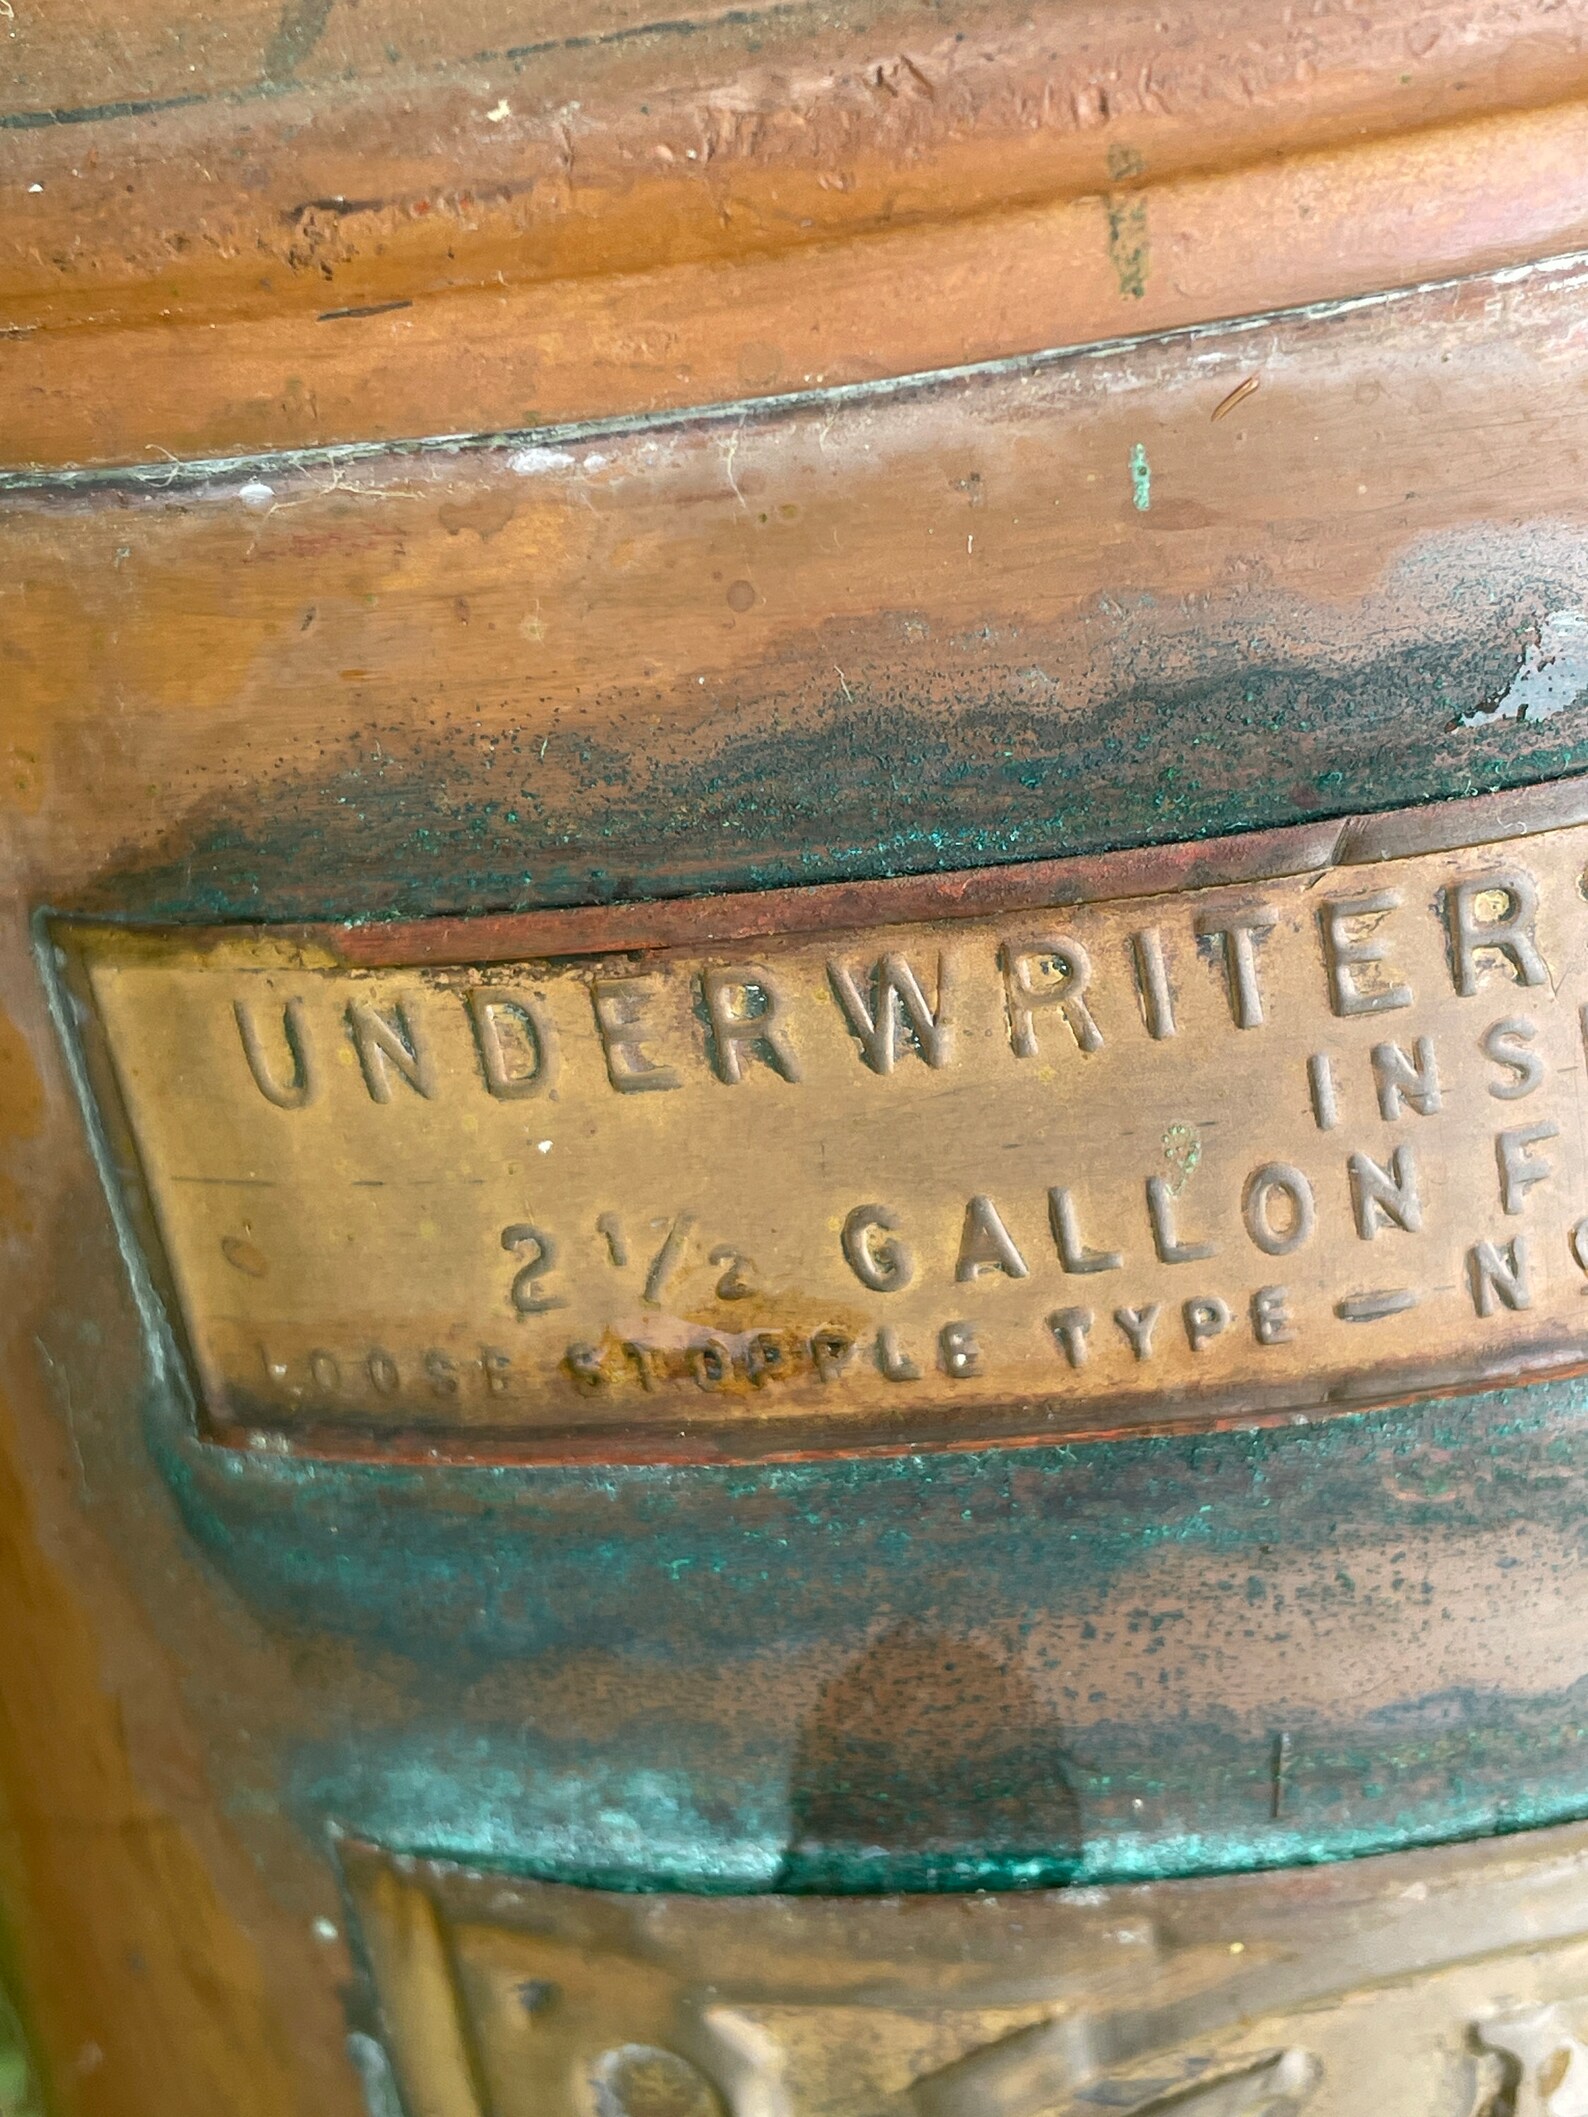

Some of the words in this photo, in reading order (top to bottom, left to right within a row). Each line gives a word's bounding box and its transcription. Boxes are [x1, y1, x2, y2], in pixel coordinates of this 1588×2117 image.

[233, 865, 1588, 1110] UNDERWRITER
[1308, 1002, 1588, 1130] INS
[840, 1144, 1423, 1293] GALLON
[563, 1318, 983, 1398] STOPPLE
[1047, 1284, 1294, 1370] TYPE
